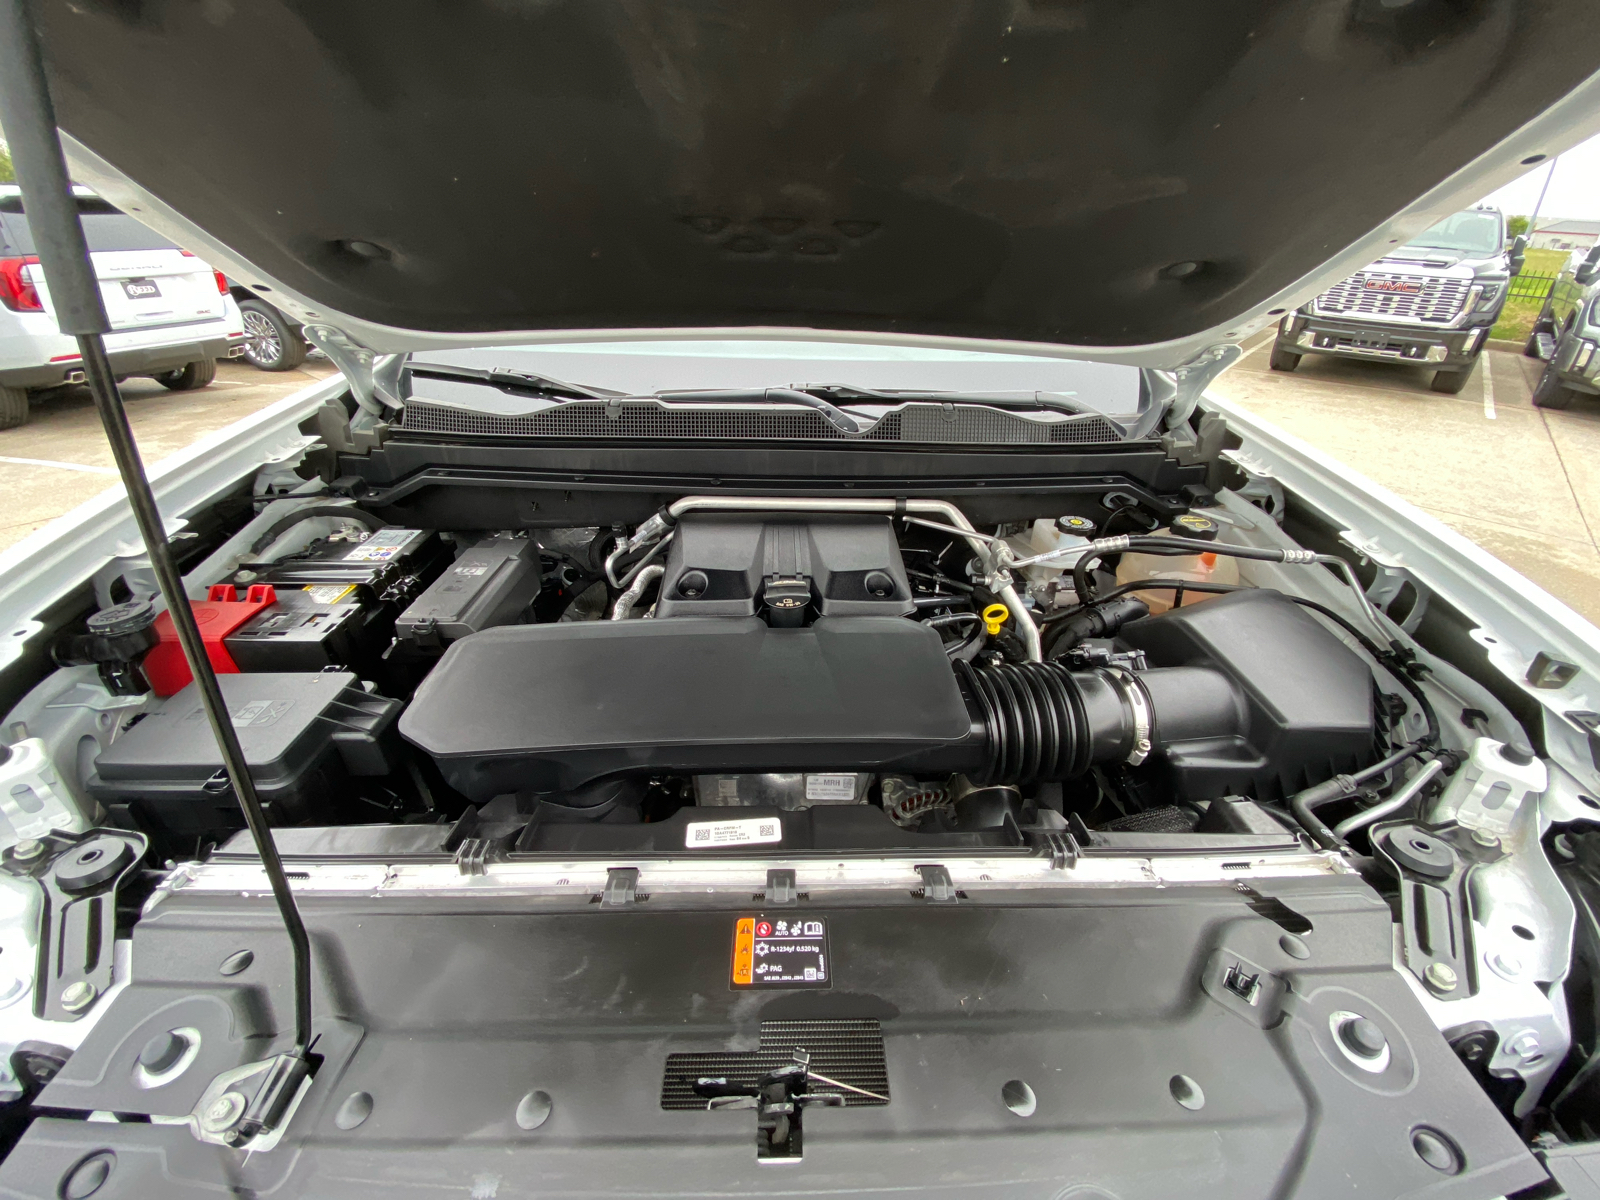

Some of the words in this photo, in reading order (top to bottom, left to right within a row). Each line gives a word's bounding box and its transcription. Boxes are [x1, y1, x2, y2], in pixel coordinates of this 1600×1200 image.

[1366, 280, 1421, 293] GMC
[770, 945, 795, 953] R-1234yf
[812, 945, 819, 953] kg
